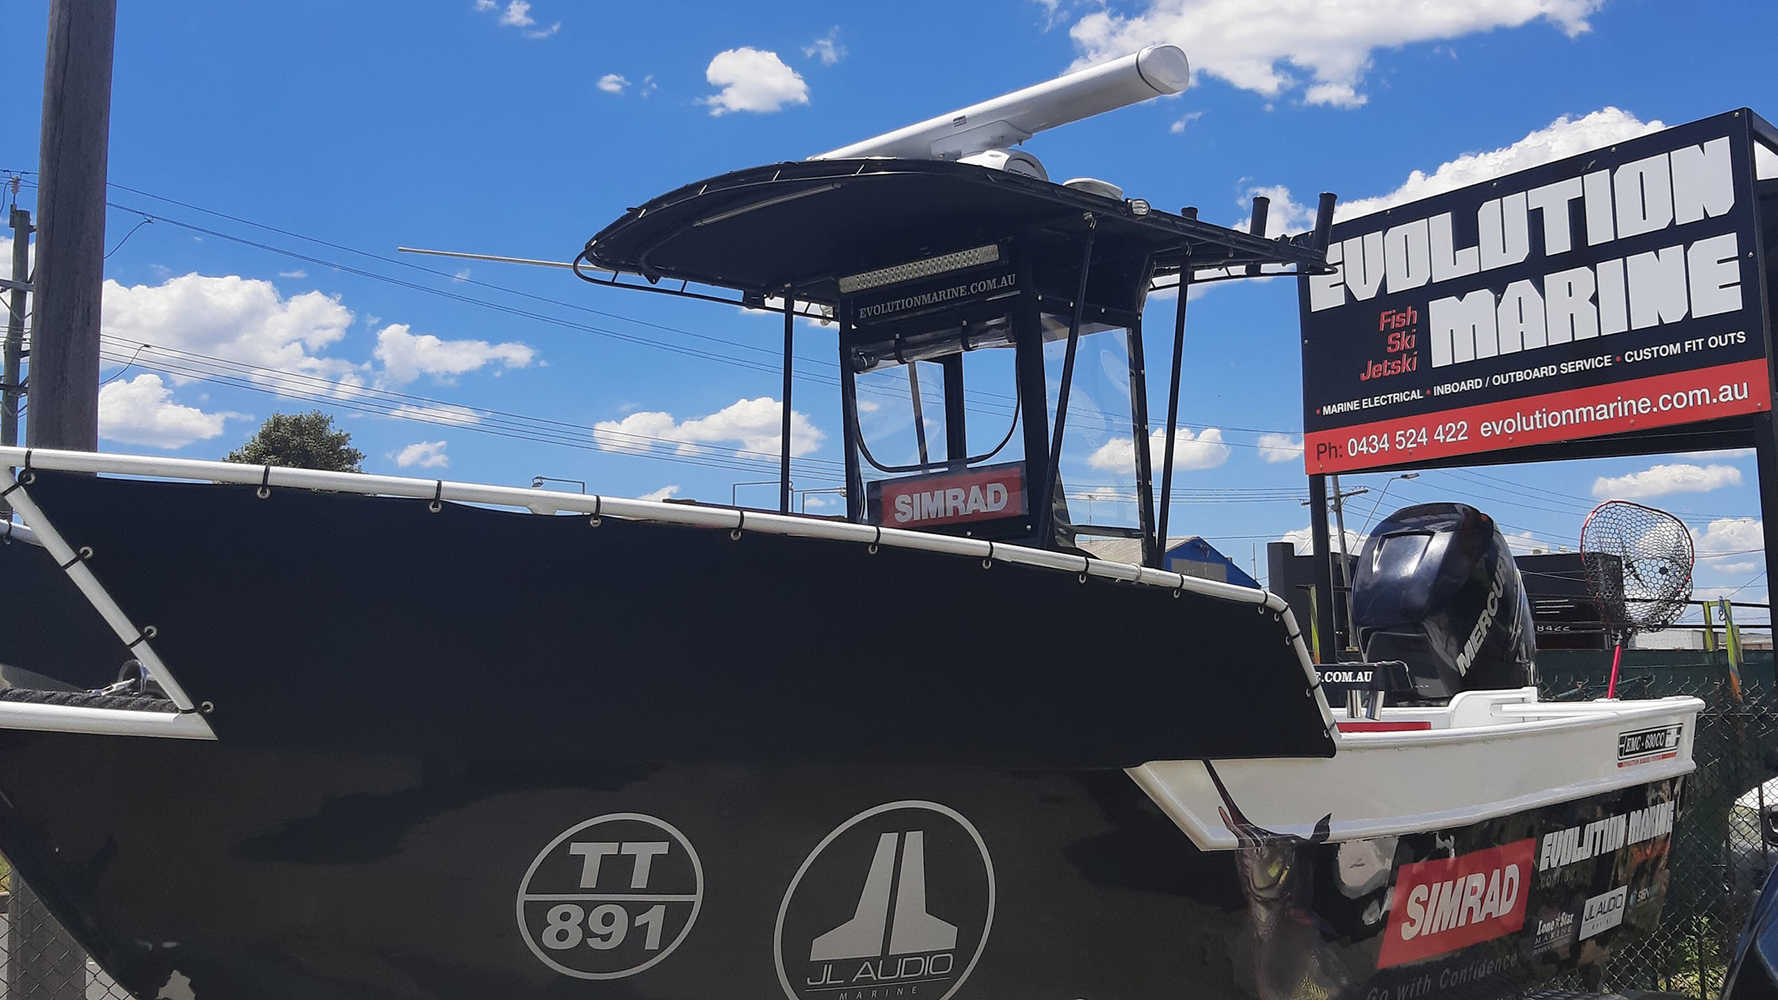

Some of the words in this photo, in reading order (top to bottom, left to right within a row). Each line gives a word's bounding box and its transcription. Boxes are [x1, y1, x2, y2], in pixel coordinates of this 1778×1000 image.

[1310, 136, 1735, 312] EVOLUTION
[859, 273, 1017, 319] EVOLUTIONMARINE.COM.AU
[1379, 305, 1417, 332] Fish
[1429, 232, 1743, 368] MARINE
[1387, 329, 1416, 353] Ski
[1322, 401, 1360, 416] MARINE
[1362, 389, 1423, 408] ELECTRICAL
[1433, 378, 1483, 397] INBOARD
[1492, 364, 1558, 386] OUTBOARD
[1560, 354, 1612, 375] SERVICE
[1624, 342, 1681, 363] CUSTOM
[1685, 338, 1705, 353] FIT
[1708, 331, 1747, 349] OUTS
[1360, 352, 1417, 381] Jetski
[1316, 442, 1343, 461] Ph:
[1347, 433, 1390, 457] 0434
[1395, 427, 1428, 450] 524
[1433, 420, 1469, 443] 422
[1479, 381, 1749, 437] evolutionmarine.com.au
[894, 482, 1009, 524] SIMRAD
[568, 841, 669, 889] TT
[1539, 813, 1627, 873] EVOLUTION
[1401, 863, 1520, 941] SIMRAD
[541, 903, 667, 951] 891
[806, 963, 844, 986] JL
[852, 953, 954, 983] AUDIO
[839, 985, 918, 1000] MARINE
[1440, 953, 1519, 989] Confidence
